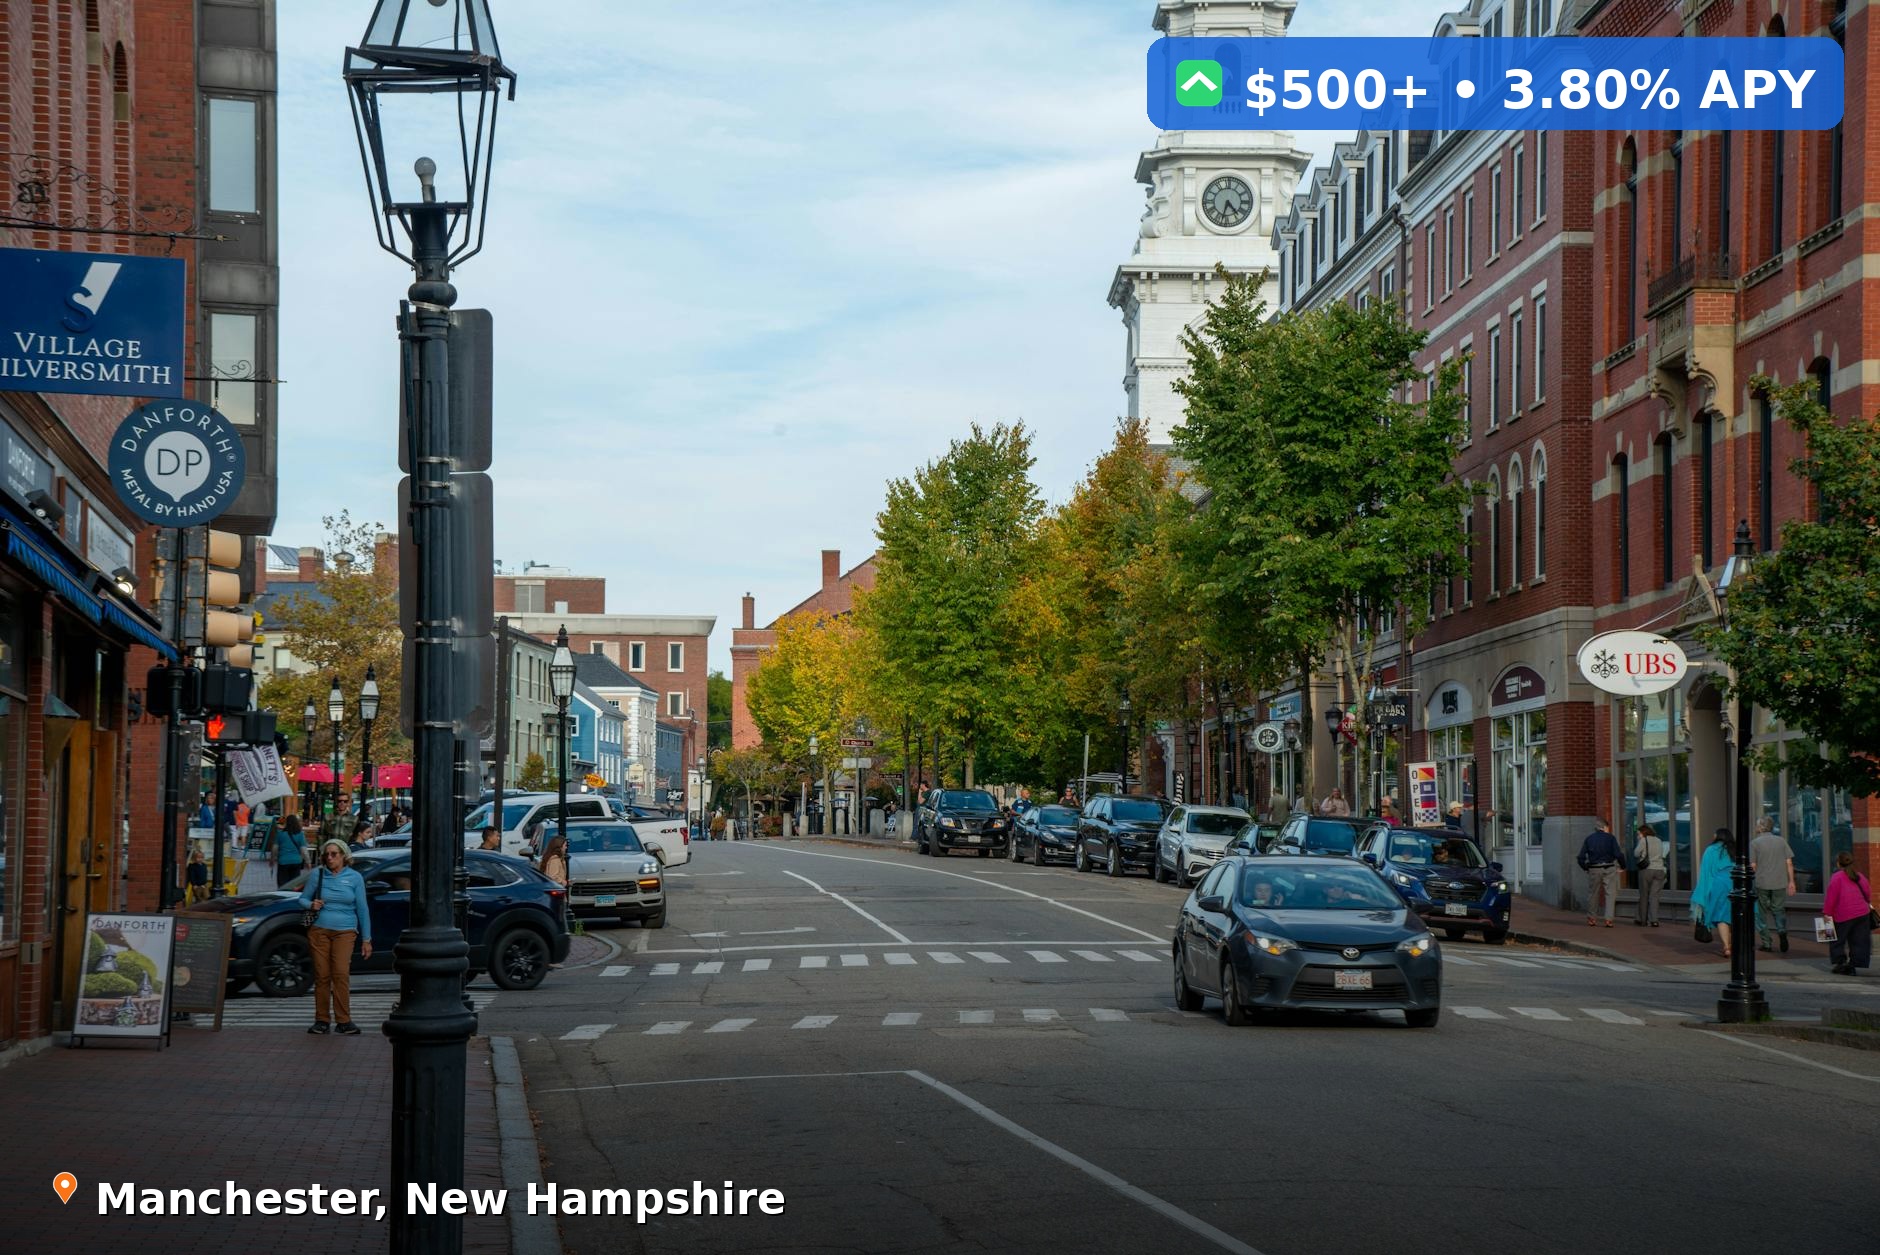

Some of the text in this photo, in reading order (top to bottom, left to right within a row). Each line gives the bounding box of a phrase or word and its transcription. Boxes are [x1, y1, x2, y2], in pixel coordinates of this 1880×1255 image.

[13, 331, 142, 359] VILLAGE
[157, 448, 203, 477] DP
[121, 468, 234, 517] METAL BY HAND USA
[1624, 653, 1677, 675] UBS
[1411, 770, 1422, 822] OPEN
[96, 919, 166, 931] DANFORTH
